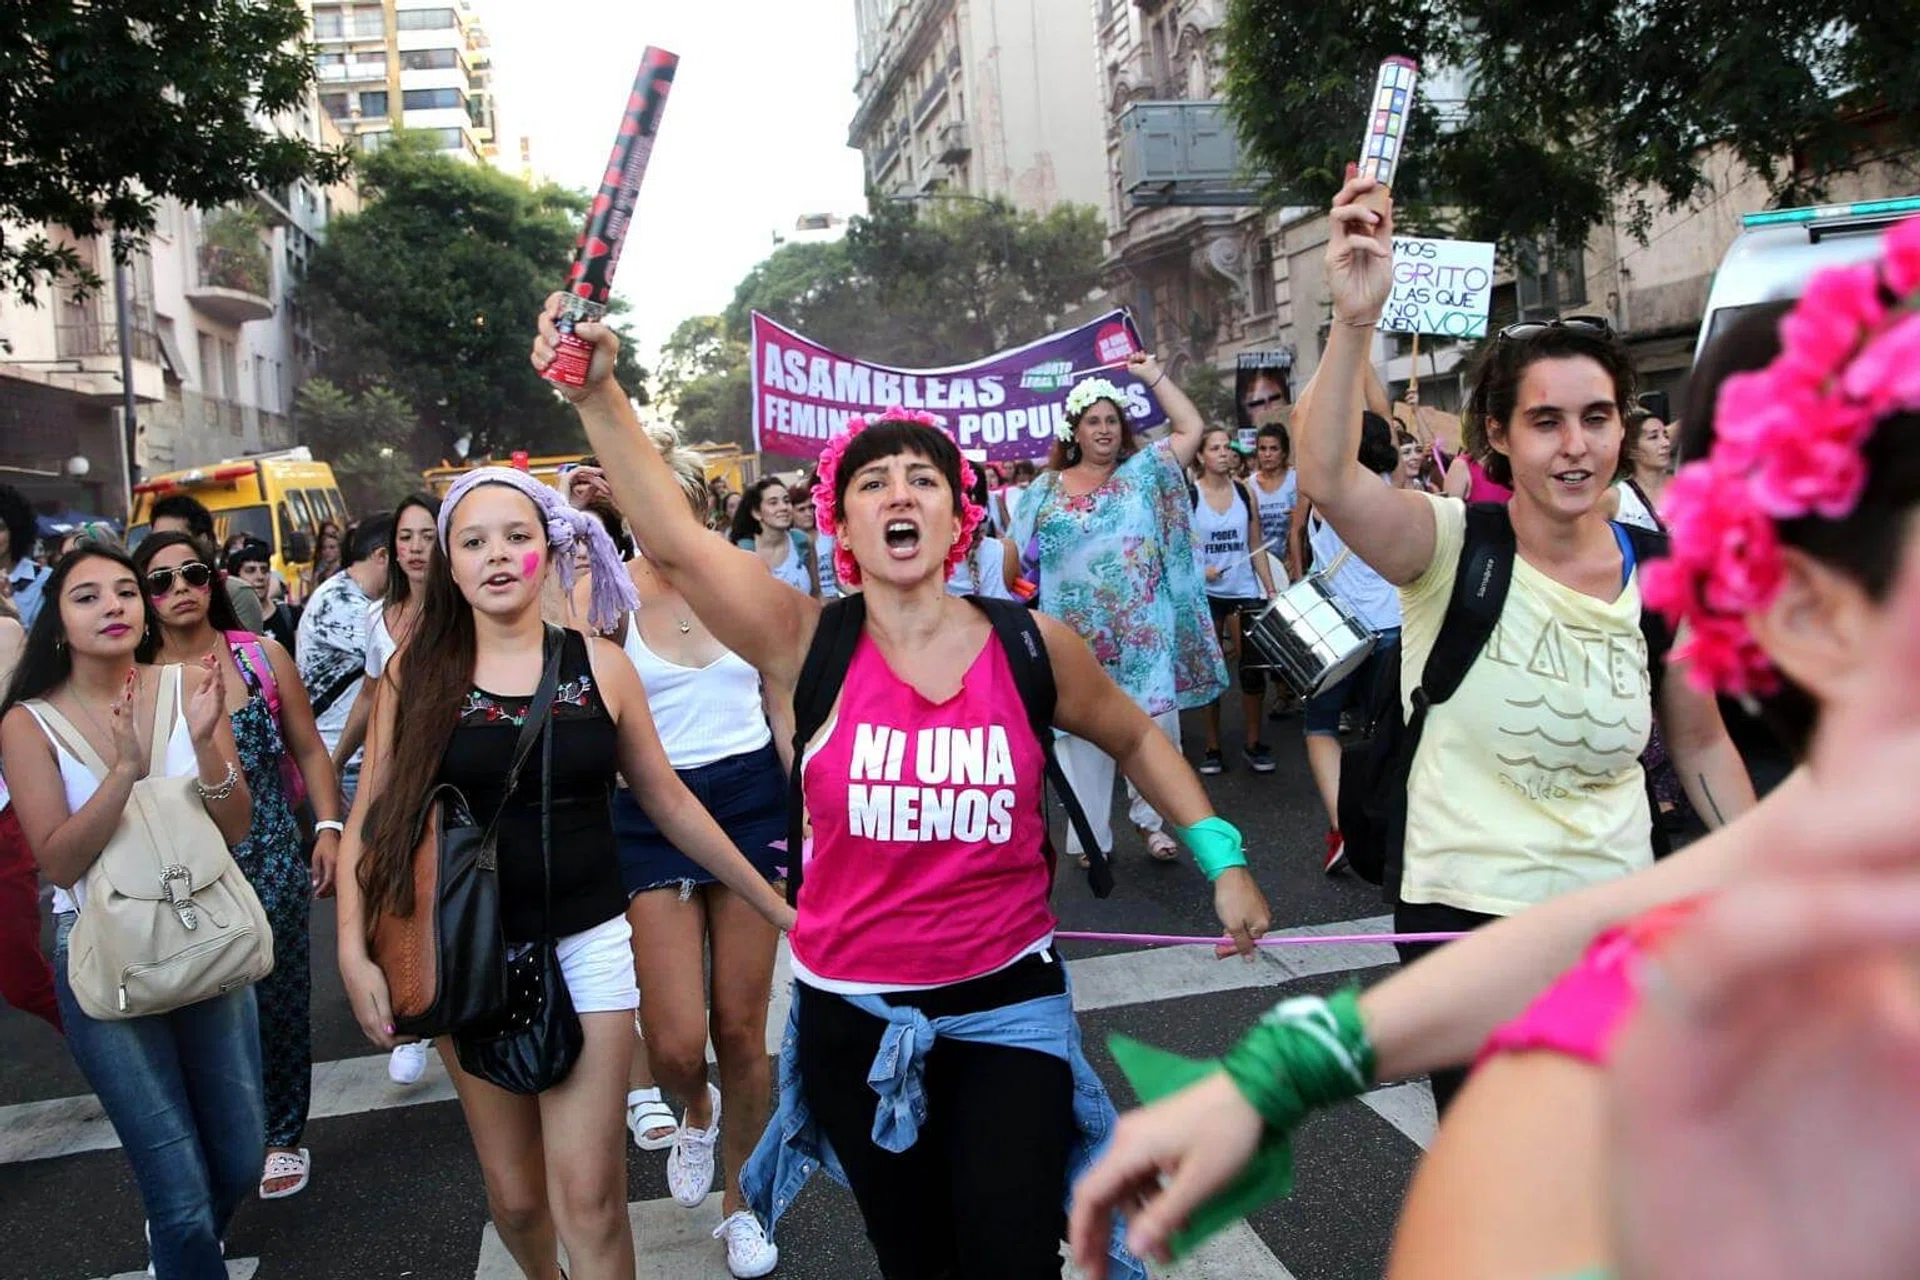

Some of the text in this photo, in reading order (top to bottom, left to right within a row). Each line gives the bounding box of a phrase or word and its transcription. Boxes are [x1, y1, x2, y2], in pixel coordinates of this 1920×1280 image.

[1393, 262, 1489, 292] GRITO
[1388, 302, 1419, 318] NO
[1393, 286, 1478, 309] LAS QUE
[1424, 310, 1489, 338] VOZ
[763, 342, 1006, 409] ASAMBLEAS
[1211, 529, 1238, 541] PODER
[850, 723, 1017, 786] NI UNA
[848, 783, 1015, 844] MENOS
